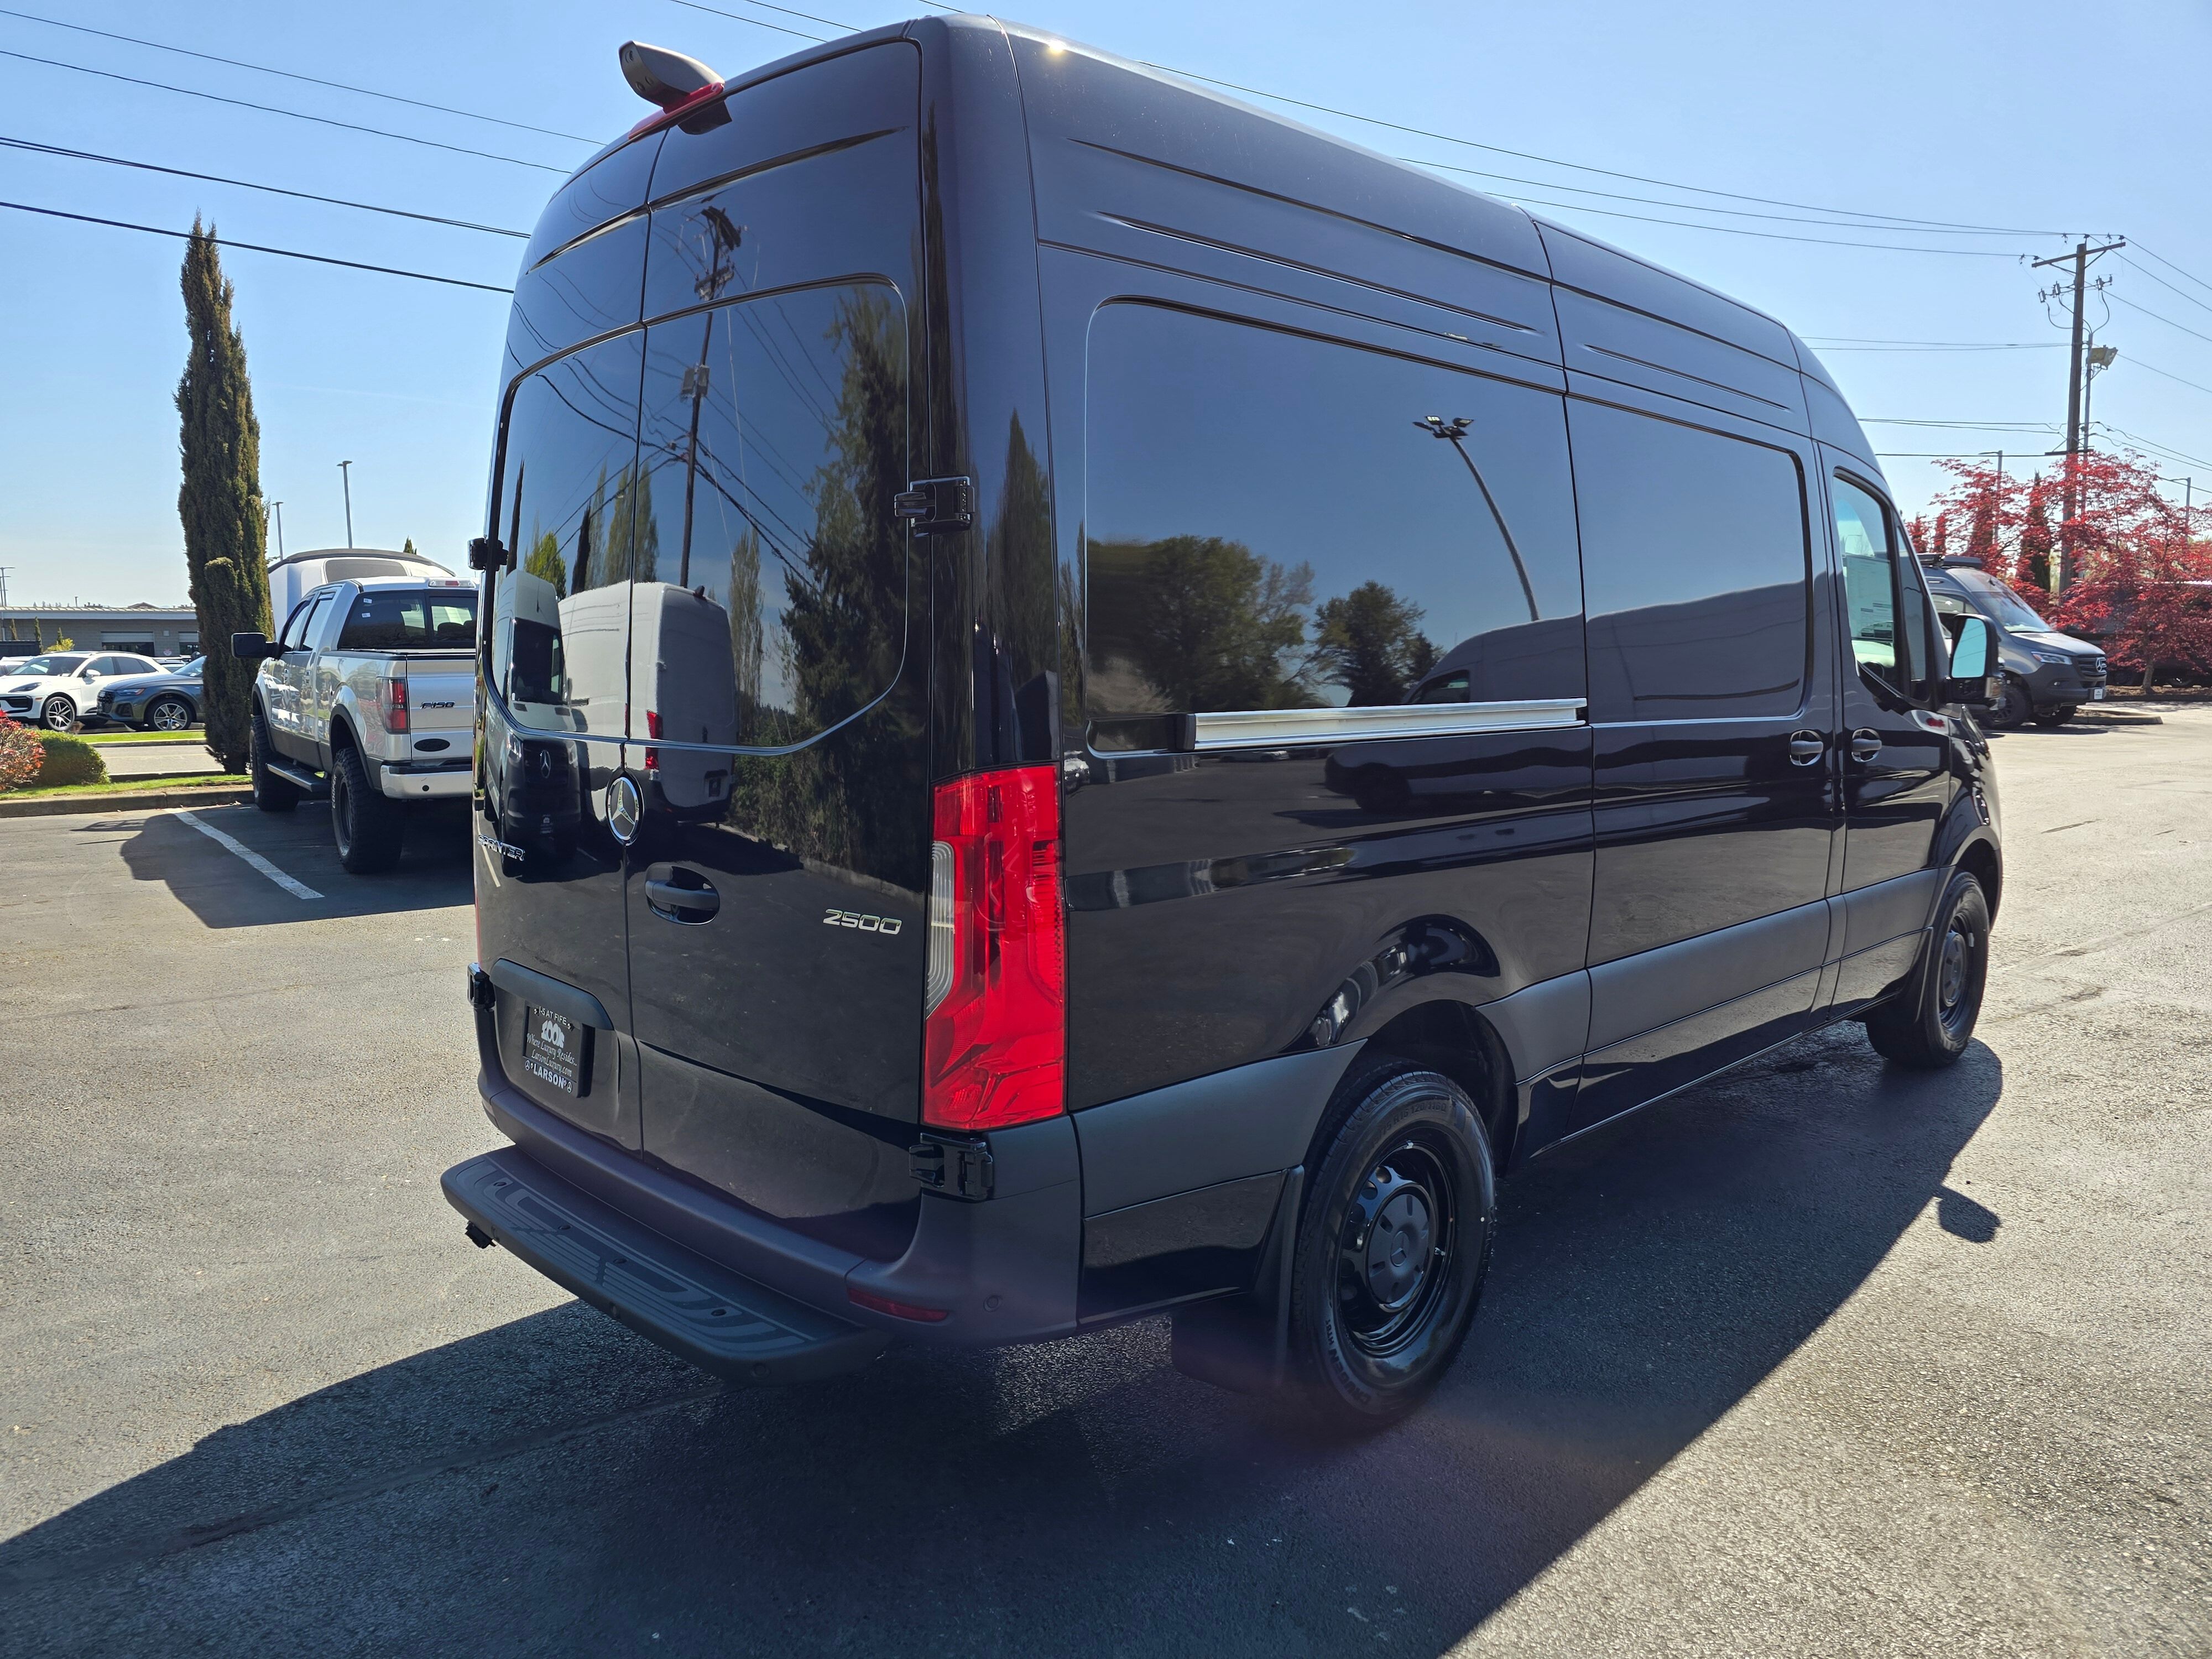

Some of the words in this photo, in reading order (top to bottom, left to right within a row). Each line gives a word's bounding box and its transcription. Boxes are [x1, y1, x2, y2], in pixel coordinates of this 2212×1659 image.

[478, 834, 525, 861] SPRINTER
[823, 909, 902, 935] 2500
[546, 1010, 554, 1019] AT
[554, 1013, 567, 1025] FIFE
[526, 1032, 541, 1048] Where
[541, 1040, 557, 1060] Luxury
[531, 1049, 572, 1077] LarsonLuxury.com
[533, 1063, 565, 1089] LARSON
